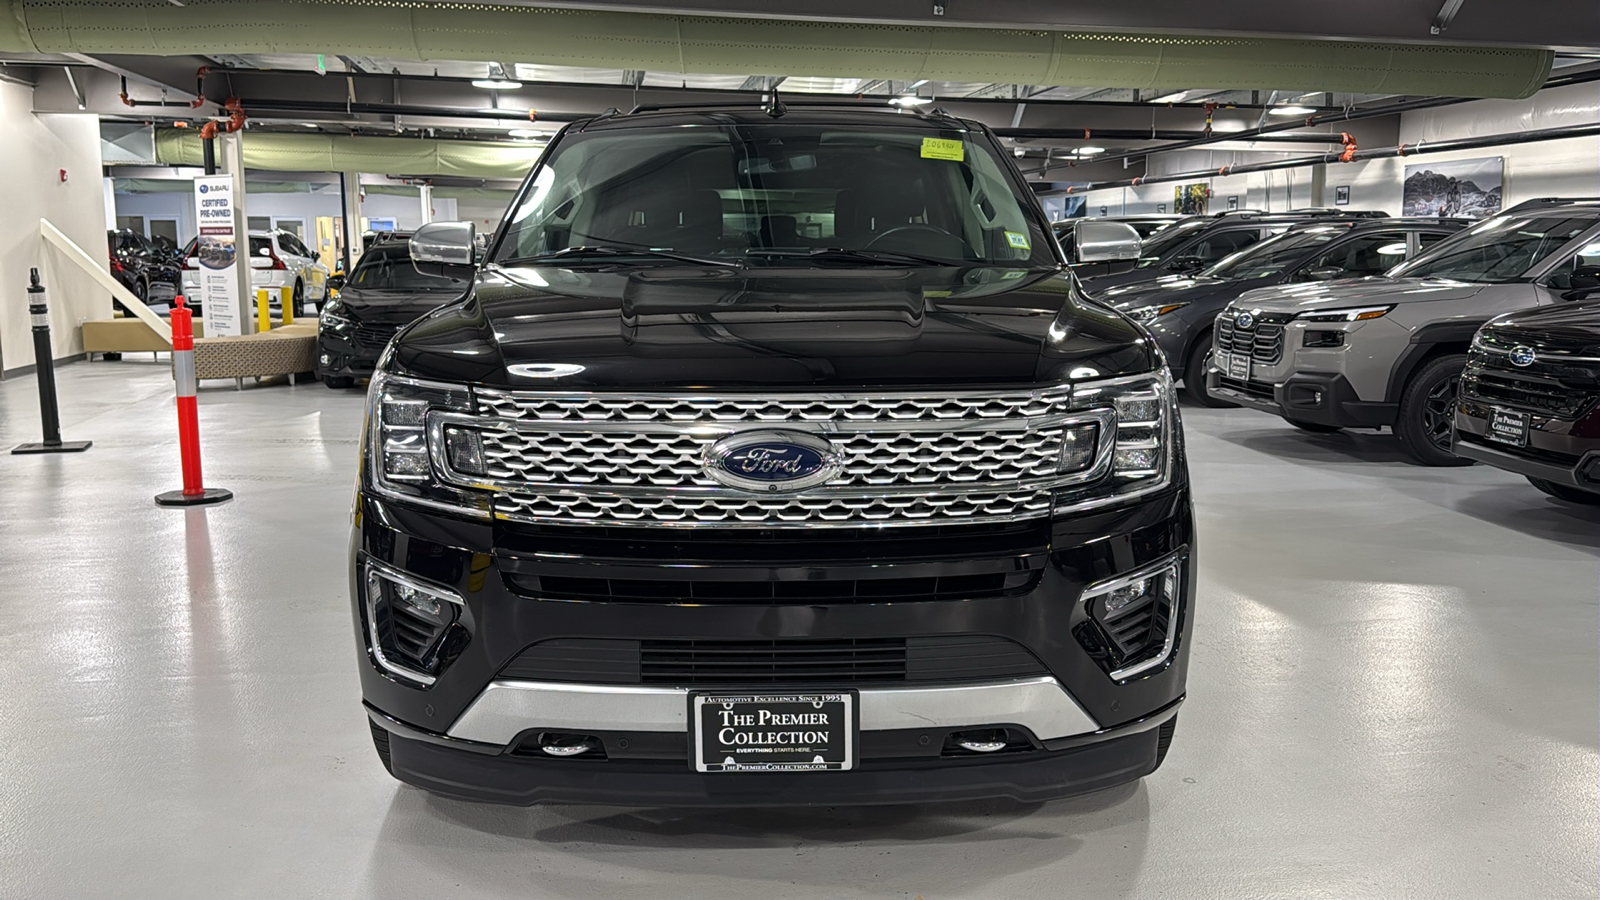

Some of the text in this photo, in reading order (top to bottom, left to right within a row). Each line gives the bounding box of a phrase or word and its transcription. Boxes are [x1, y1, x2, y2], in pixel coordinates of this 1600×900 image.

[201, 198, 229, 207] CERTIFIED
[200, 209, 231, 218] PRE-OWNED
[1503, 415, 1523, 426] PREMIER
[1492, 421, 1522, 435] COLLECTION
[733, 447, 803, 473] Ford
[821, 694, 841, 702] 1995
[718, 709, 829, 726] THE PREMIER
[718, 727, 829, 745] COLLECTION
